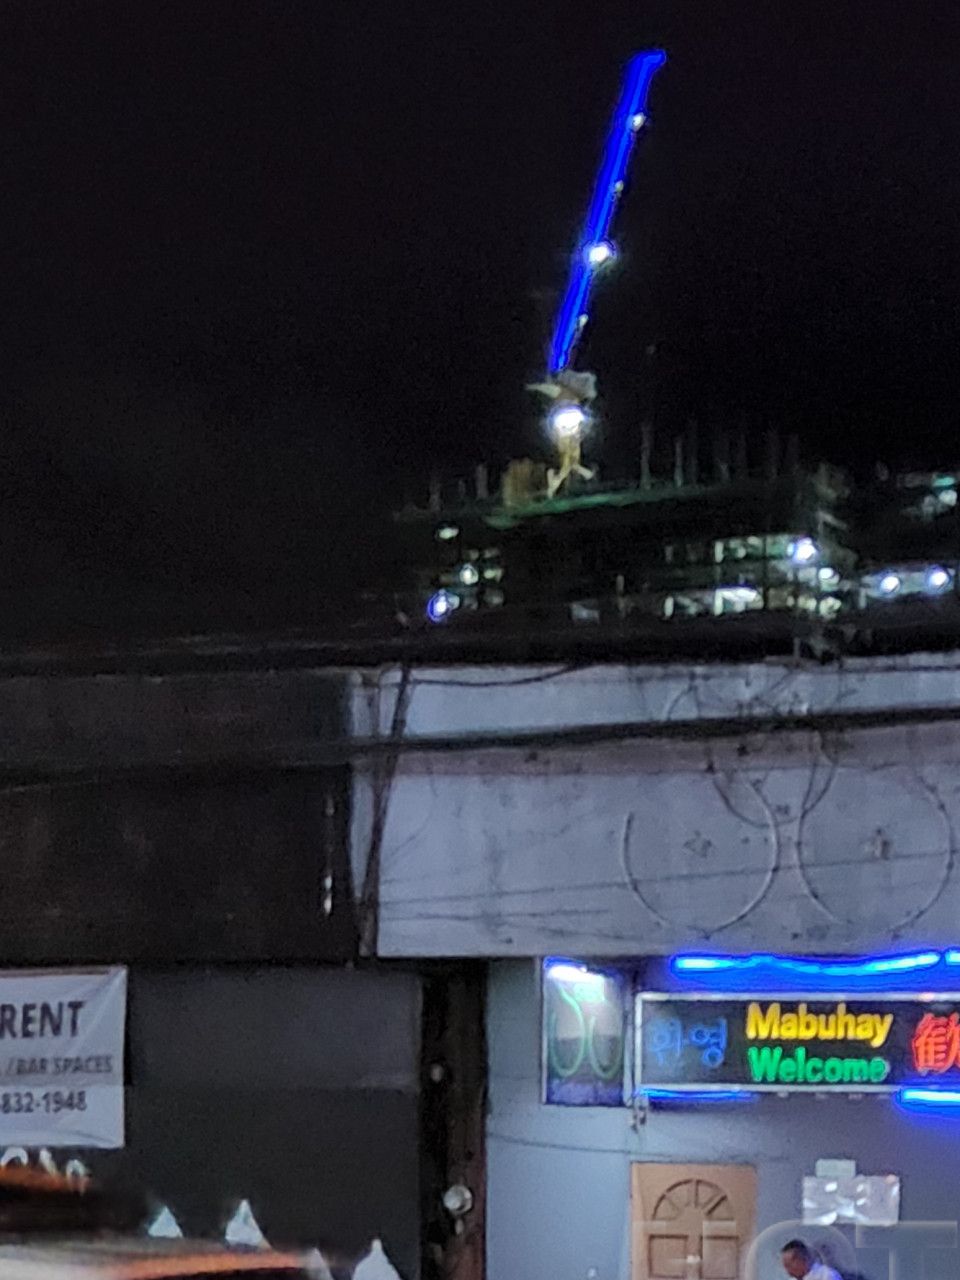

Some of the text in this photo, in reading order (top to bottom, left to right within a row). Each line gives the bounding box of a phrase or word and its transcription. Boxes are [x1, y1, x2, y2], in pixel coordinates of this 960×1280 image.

[0, 1002, 83, 1038] RENT
[746, 1002, 893, 1048] Mabuhay
[53, 1054, 113, 1075] SPACES
[748, 1045, 890, 1082] Welcome
